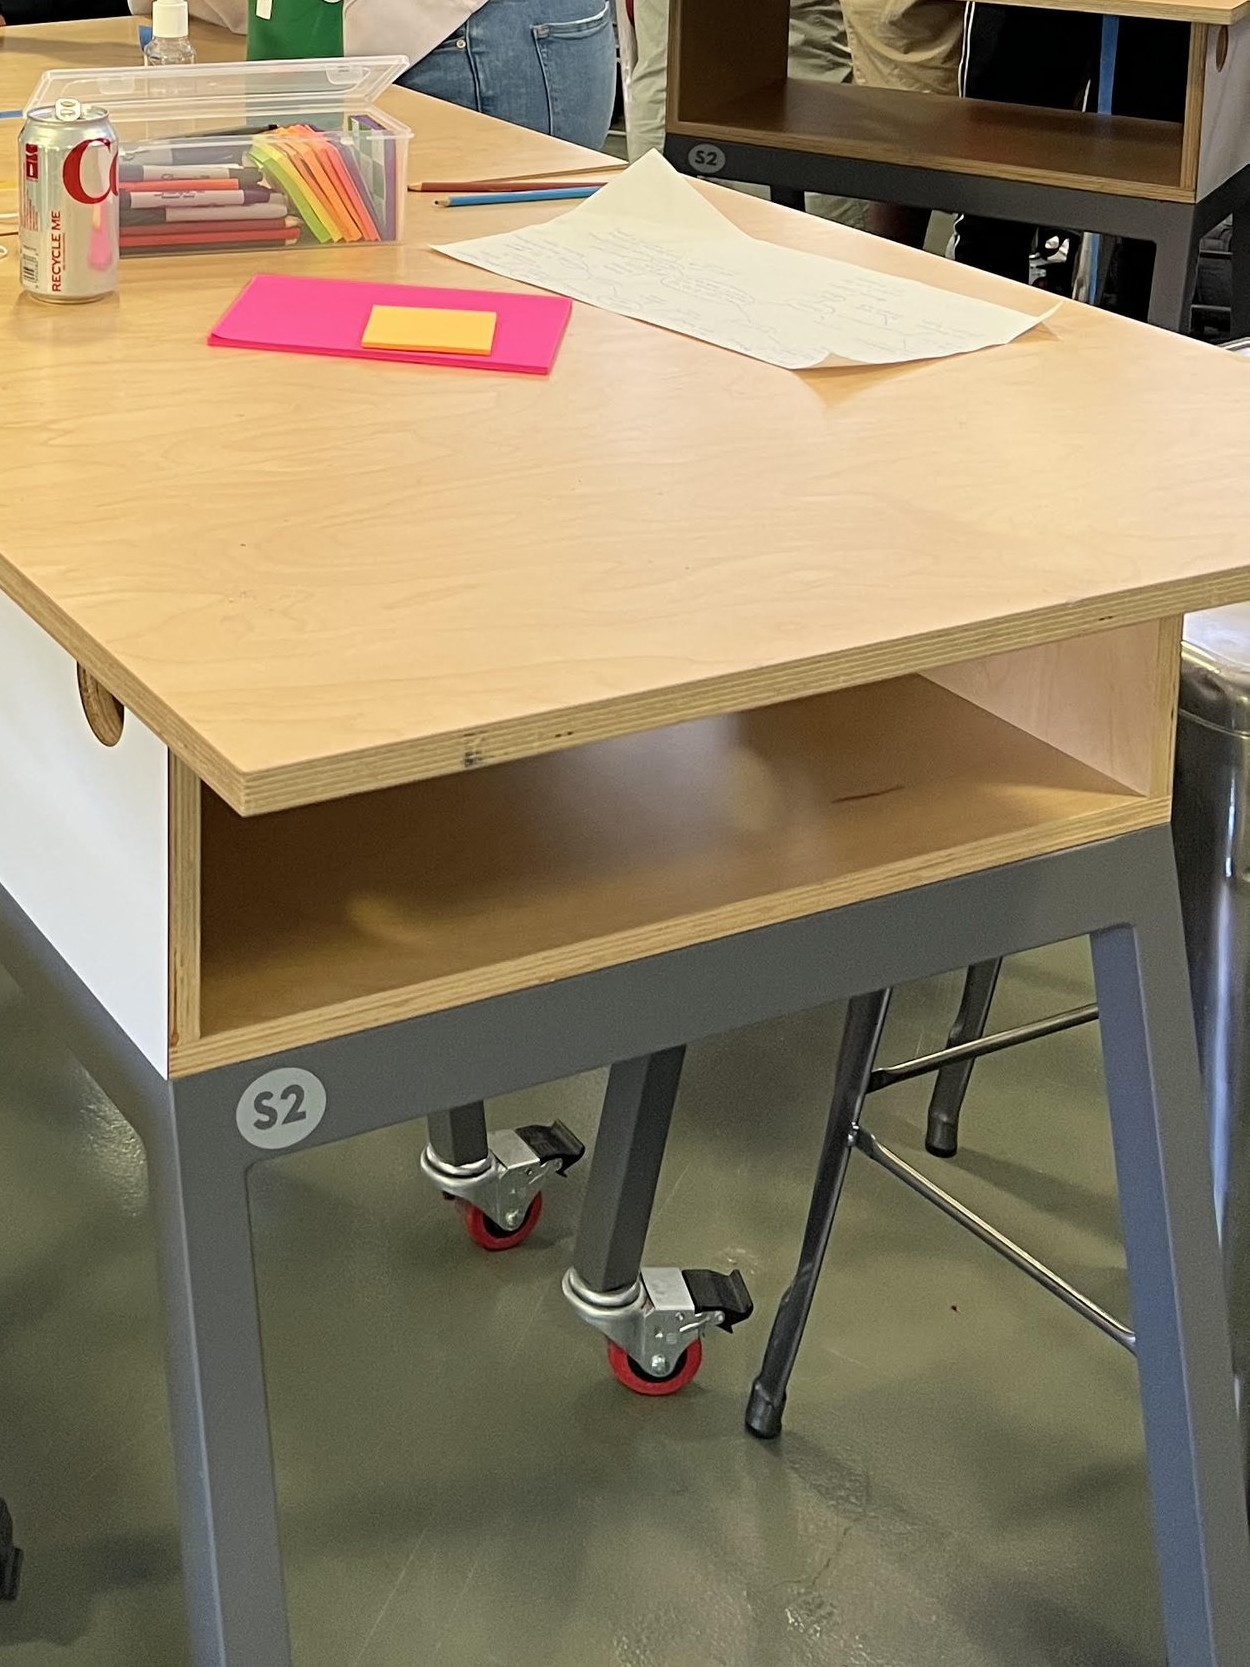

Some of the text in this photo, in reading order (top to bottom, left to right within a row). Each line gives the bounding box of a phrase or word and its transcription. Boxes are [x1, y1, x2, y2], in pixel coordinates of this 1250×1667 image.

[694, 149, 718, 167] S2
[51, 210, 62, 292] RECYCLE ME
[252, 1083, 307, 1131] S2
